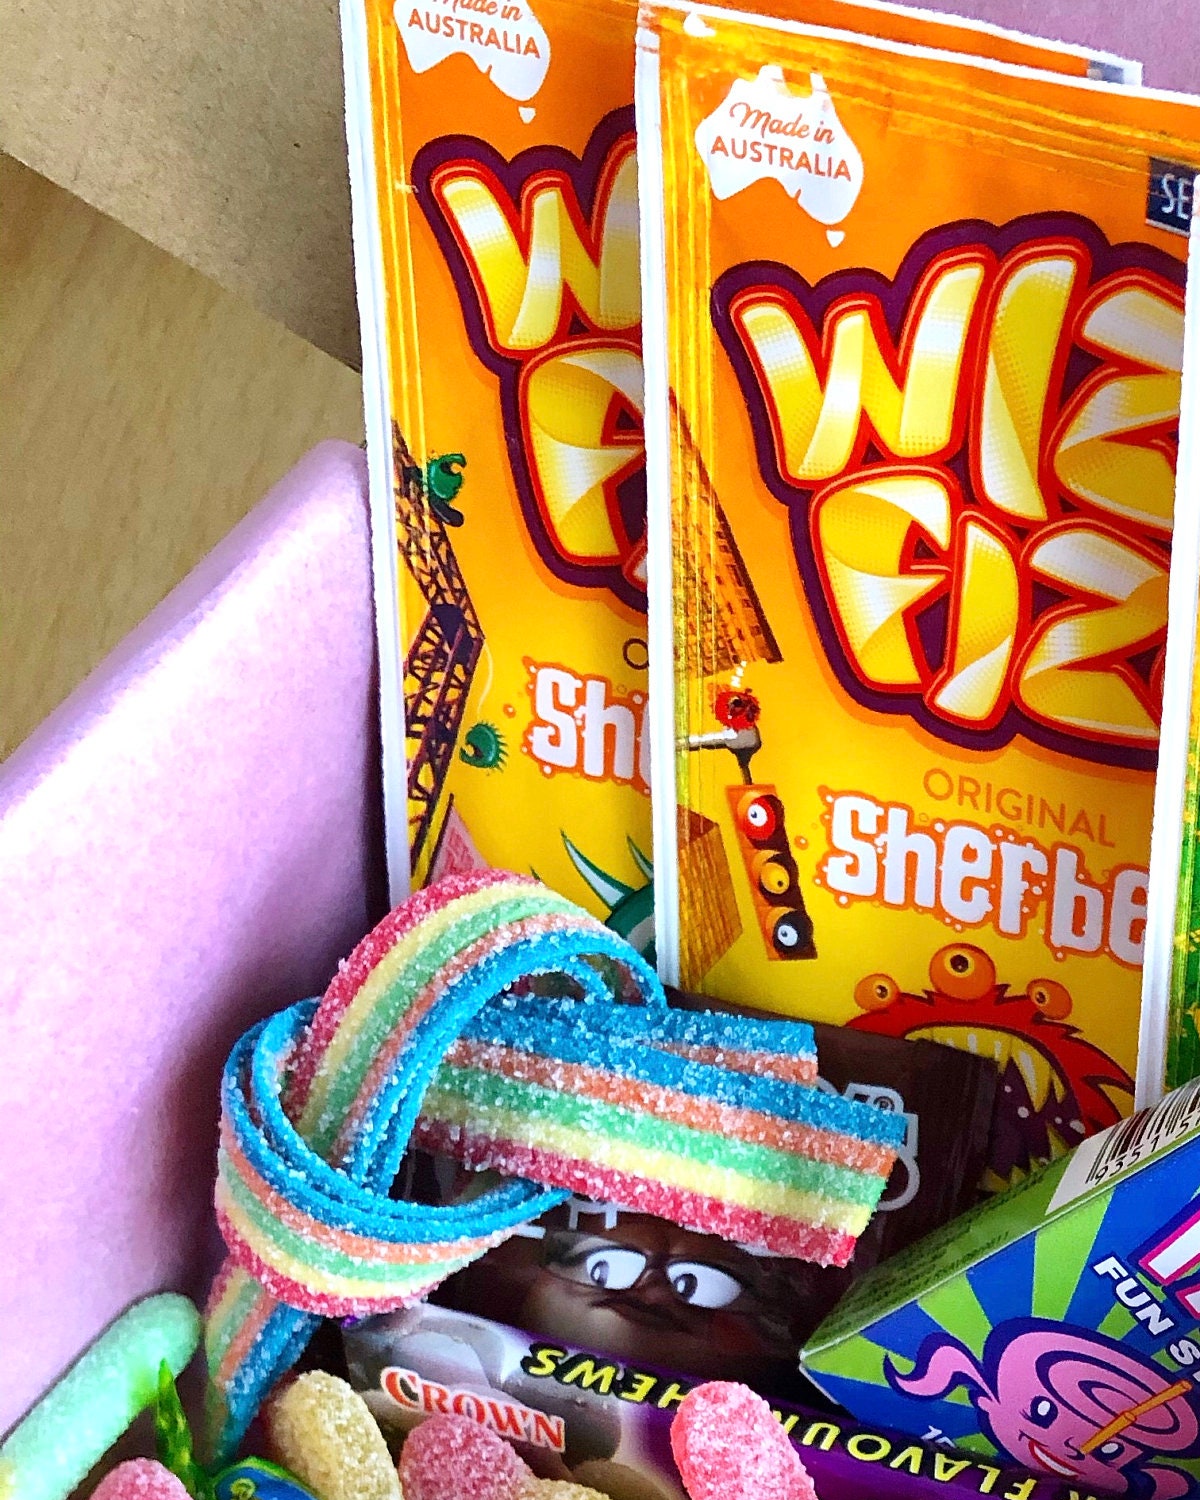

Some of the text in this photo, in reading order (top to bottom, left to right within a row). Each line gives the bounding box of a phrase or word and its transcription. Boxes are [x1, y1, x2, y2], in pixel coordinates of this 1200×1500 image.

[408, 9, 541, 58] AUSTRALIA
[711, 135, 851, 181] AUSTRALIA
[729, 102, 835, 144] Made in
[722, 235, 1186, 522] WIZ
[808, 464, 1165, 738] FIZ
[921, 768, 1116, 848] ORIGINAL
[1093, 1255, 1171, 1338] FUN
[381, 1367, 565, 1453] CROWN
[527, 1347, 688, 1409] HEWS
